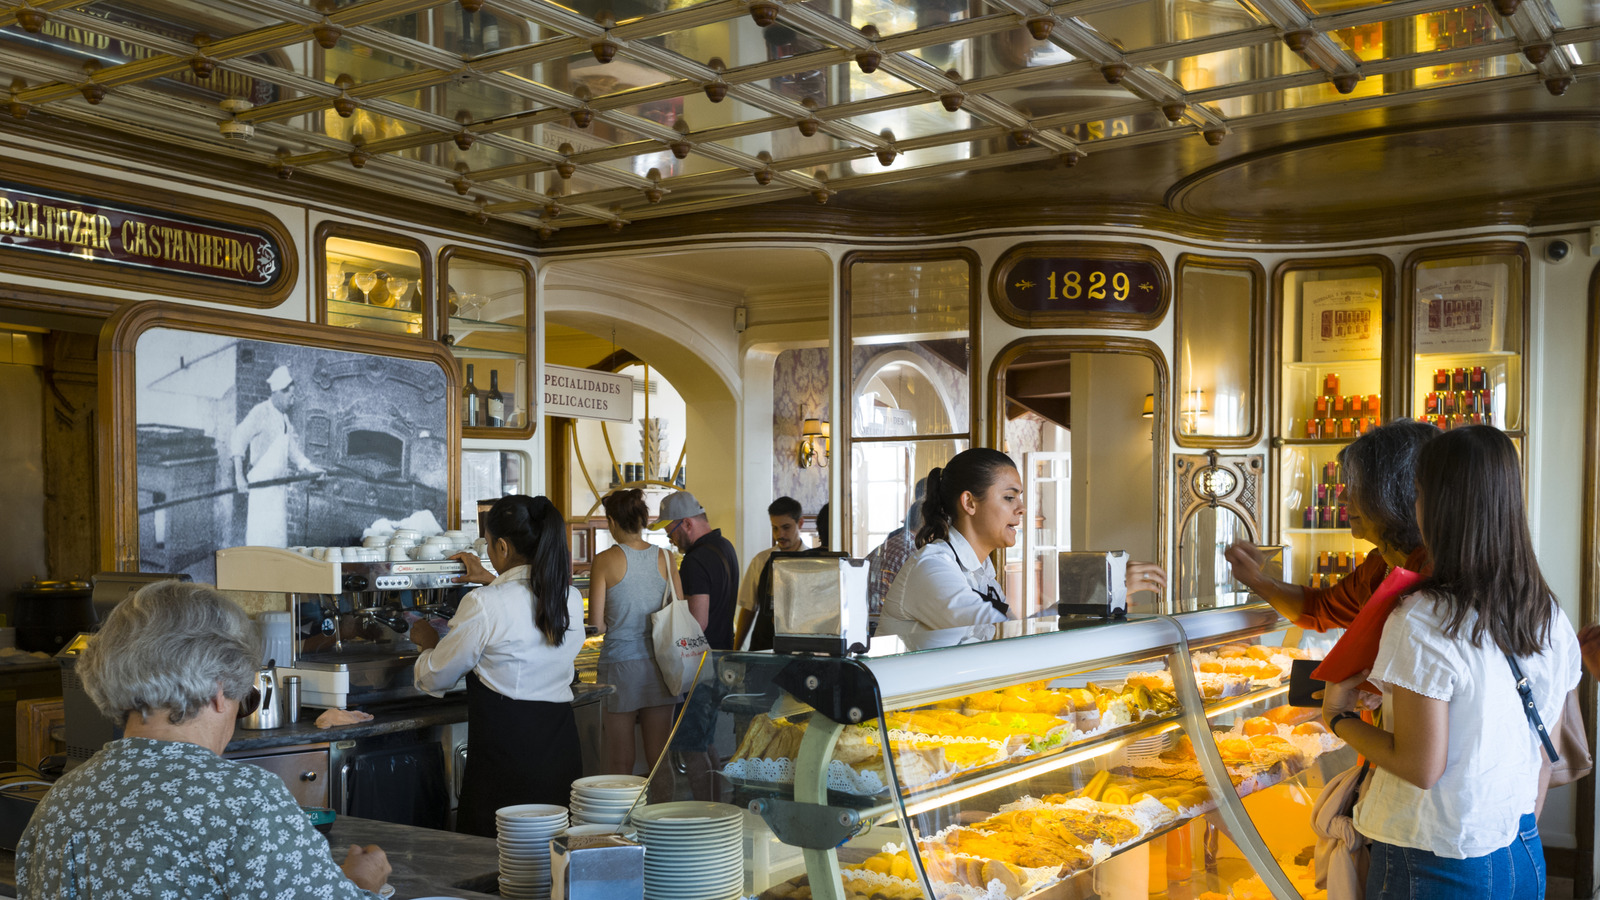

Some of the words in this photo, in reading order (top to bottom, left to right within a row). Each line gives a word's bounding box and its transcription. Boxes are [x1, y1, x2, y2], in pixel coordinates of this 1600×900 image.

[0, 196, 114, 257] BALTAZAR
[121, 219, 255, 277] CASTANHEIRO
[1047, 270, 1130, 301] 1829
[544, 374, 621, 395] PECIALIDADES
[544, 392, 609, 411] DELICACIES
